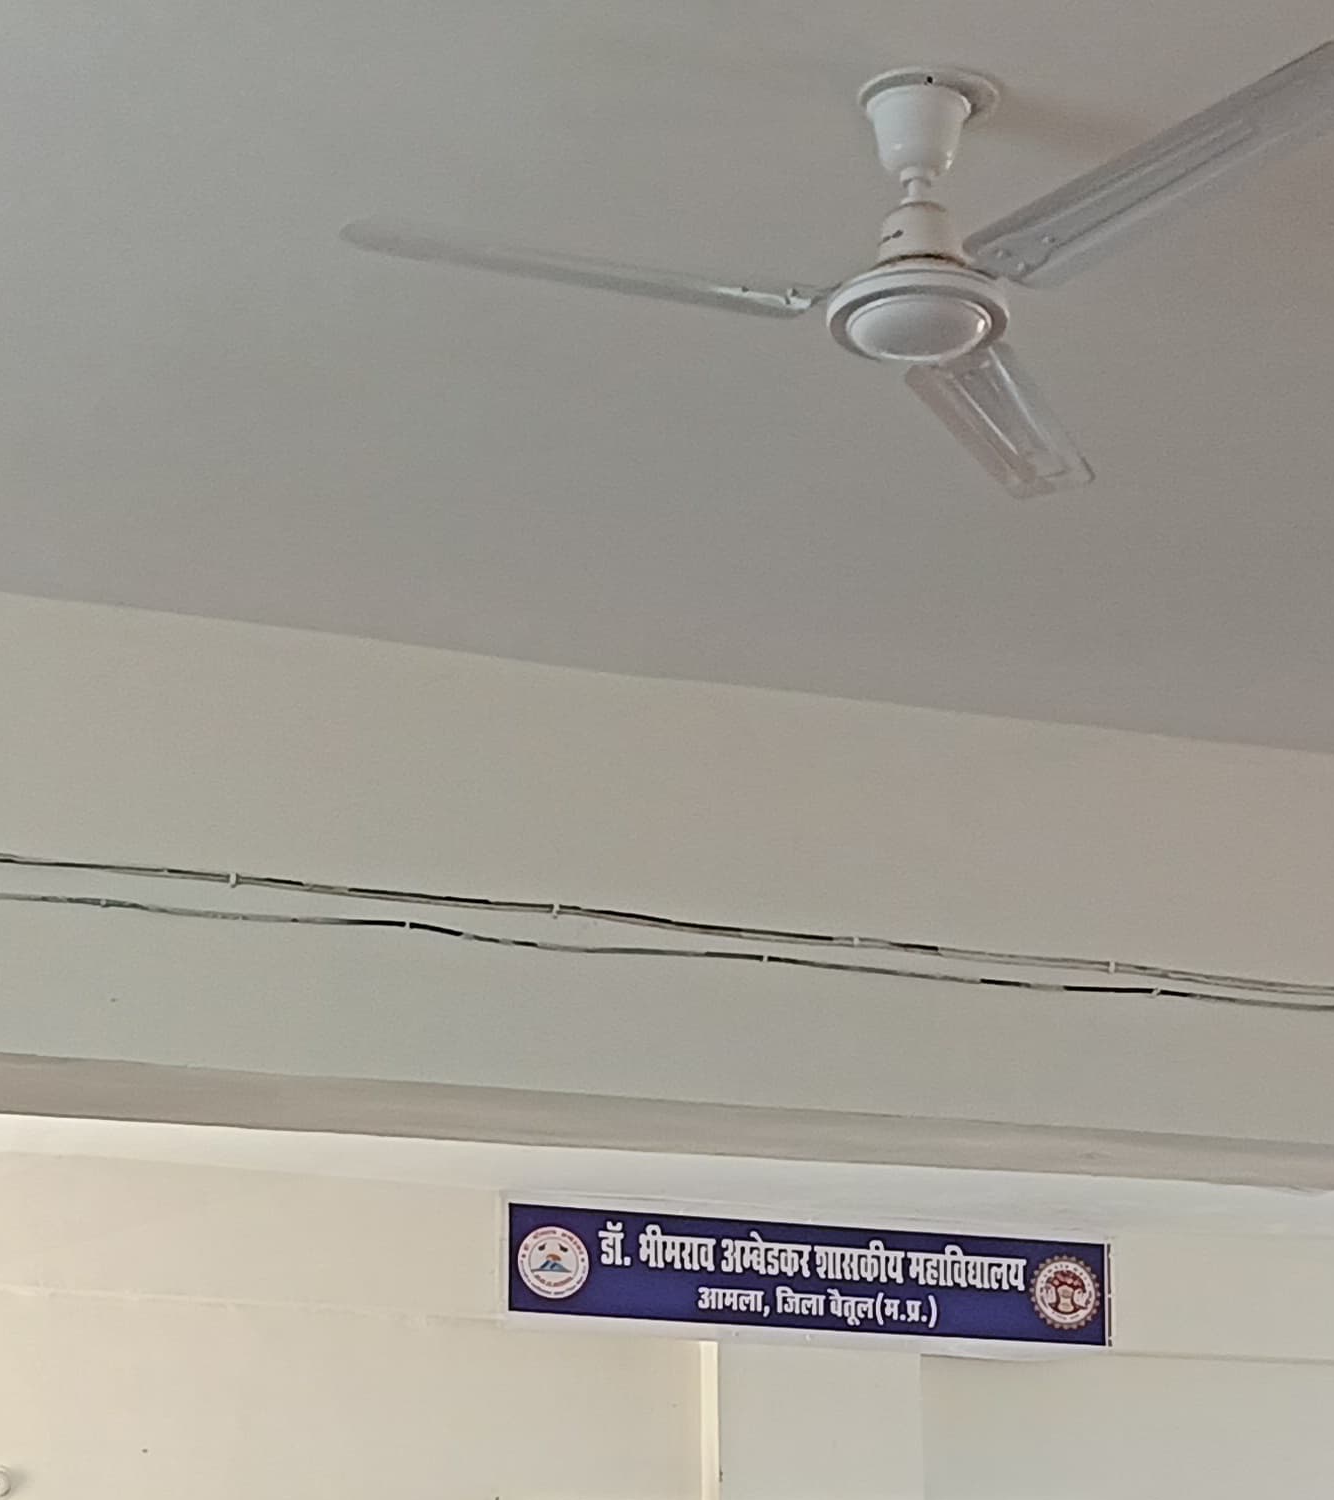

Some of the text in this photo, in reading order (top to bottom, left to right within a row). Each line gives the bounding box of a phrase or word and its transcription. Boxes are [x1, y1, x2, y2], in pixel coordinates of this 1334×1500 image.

[598, 1221, 632, 1266] डॉ.
[639, 1224, 717, 1272] भीमराव
[721, 1230, 812, 1278] अम्बेडकर
[814, 1239, 905, 1284] शासकीय
[907, 1244, 1027, 1291] महाविद्यालय
[698, 1286, 770, 1317] आमला,
[775, 1286, 826, 1316] जिला
